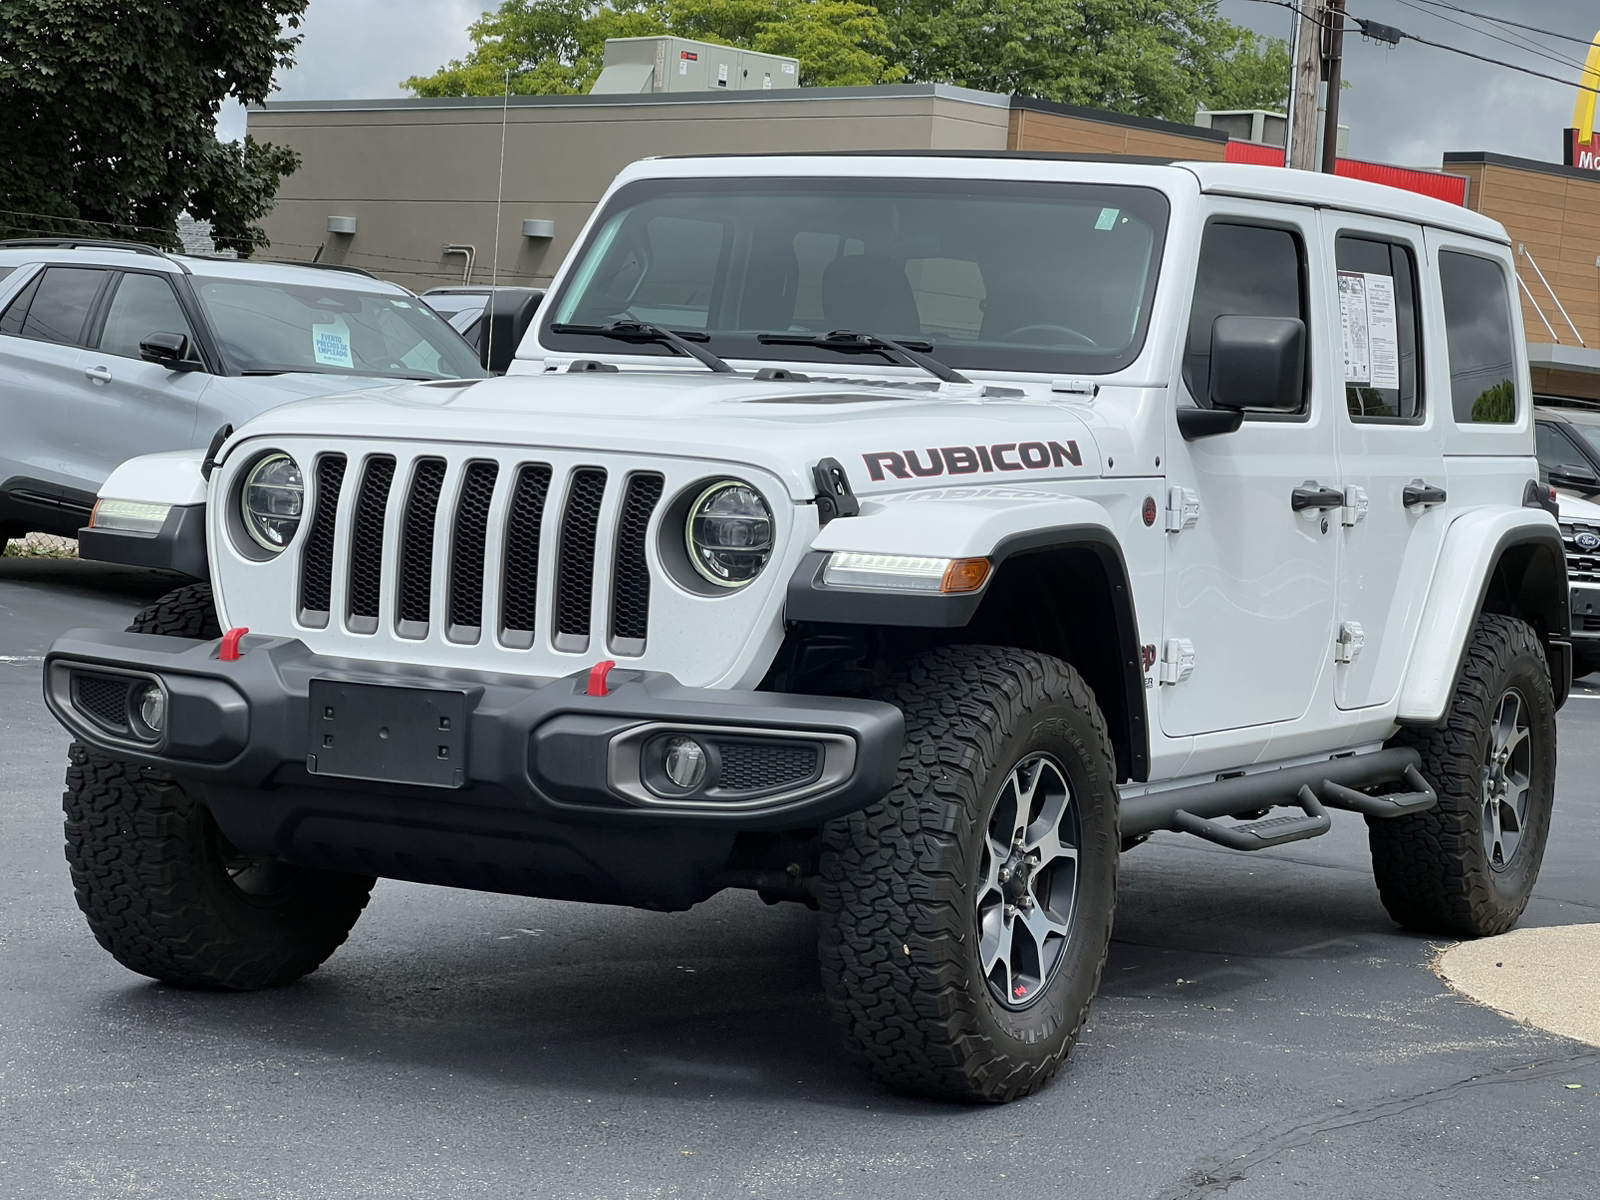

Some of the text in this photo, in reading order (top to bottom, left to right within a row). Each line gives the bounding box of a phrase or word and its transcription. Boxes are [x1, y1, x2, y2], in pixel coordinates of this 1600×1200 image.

[321, 333, 342, 343] EVENTO
[316, 340, 339, 350] PRECIOS
[318, 347, 348, 357] EMPLEADO
[861, 440, 1083, 482] RUBICON
